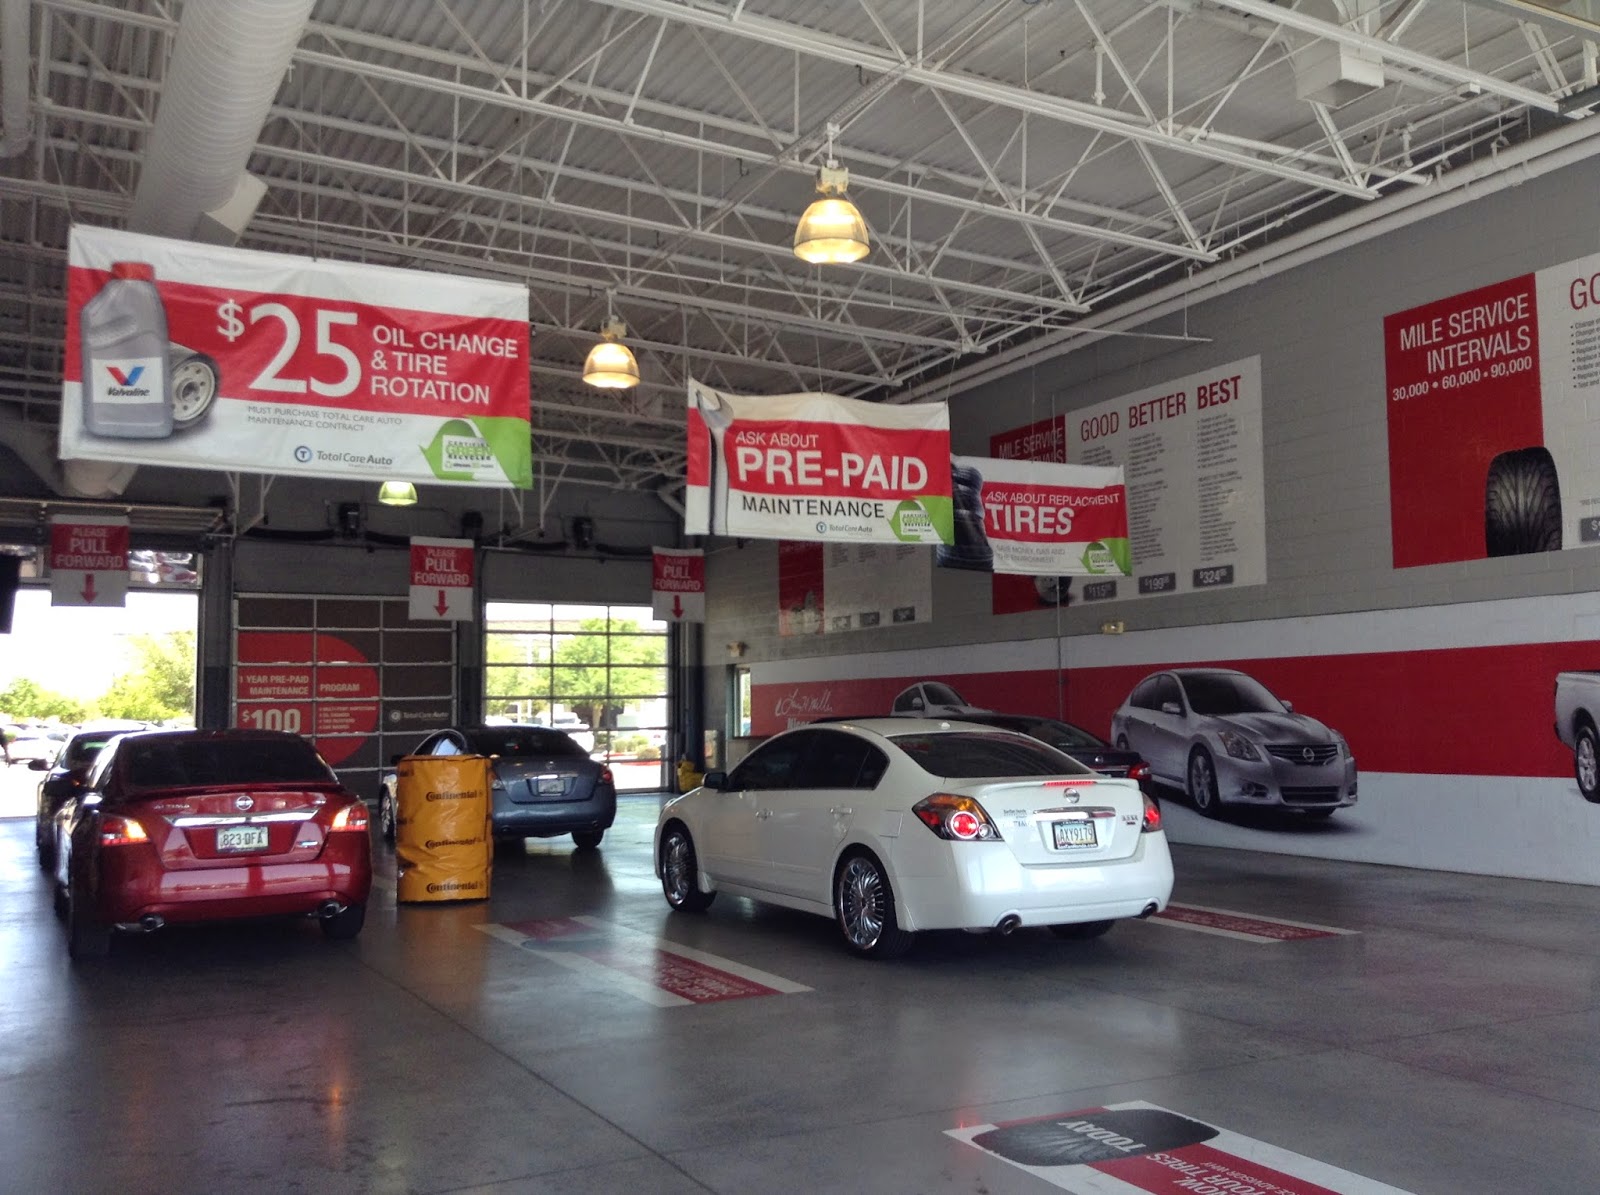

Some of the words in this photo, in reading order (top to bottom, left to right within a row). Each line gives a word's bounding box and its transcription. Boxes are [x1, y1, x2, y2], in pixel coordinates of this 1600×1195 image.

[1400, 317, 1444, 351] MILE
[1448, 293, 1530, 338] SERVICE
[217, 299, 362, 397] $25
[372, 324, 414, 348] OIL
[419, 331, 519, 358] CHANGE
[1426, 325, 1531, 374] INTERVALS
[371, 350, 387, 371] &
[392, 351, 448, 376] TIRE
[1392, 381, 1430, 401] 30,000
[1441, 367, 1481, 390] 60,000
[1490, 355, 1533, 378] 90,000
[107, 387, 150, 397] Valvoline
[371, 375, 490, 405] ROTATION
[248, 405, 272, 415] MUST
[274, 407, 320, 419] PURCHASE
[322, 411, 351, 421] TOTAL
[352, 414, 375, 424] CARE
[377, 417, 402, 425] AUTO
[1080, 410, 1120, 442] GOOD
[1128, 391, 1187, 429] BETTER
[1196, 375, 1242, 410] BEST
[247, 415, 313, 428] MAINTENANCE
[315, 421, 365, 432] CONTRACT
[735, 431, 767, 445] ASK
[770, 433, 819, 448] ABOUT
[998, 439, 1021, 460] MILE
[736, 446, 928, 491] PRE-PAID
[742, 495, 885, 519] MAINTENANCE
[986, 491, 1008, 502] ASK
[1009, 492, 1046, 505] ABOUT
[984, 502, 1075, 535] TIRES
[70, 537, 111, 554] PULL
[55, 554, 124, 568] FORWARD
[425, 557, 459, 573] PULL
[414, 571, 470, 586] FORWARD
[663, 565, 691, 579] PULL
[655, 578, 701, 591] FORWARD
[246, 675, 268, 684] YEAR
[270, 675, 309, 684] PRE-PAID
[320, 683, 360, 692] PROGRAM
[249, 686, 309, 695] MAINTENANCE
[242, 708, 301, 733] $100
[426, 789, 477, 802] Continental
[426, 882, 478, 894] Continental
[1057, 1120, 1147, 1152] TODAY
[1146, 1152, 1209, 1177] TIRES
